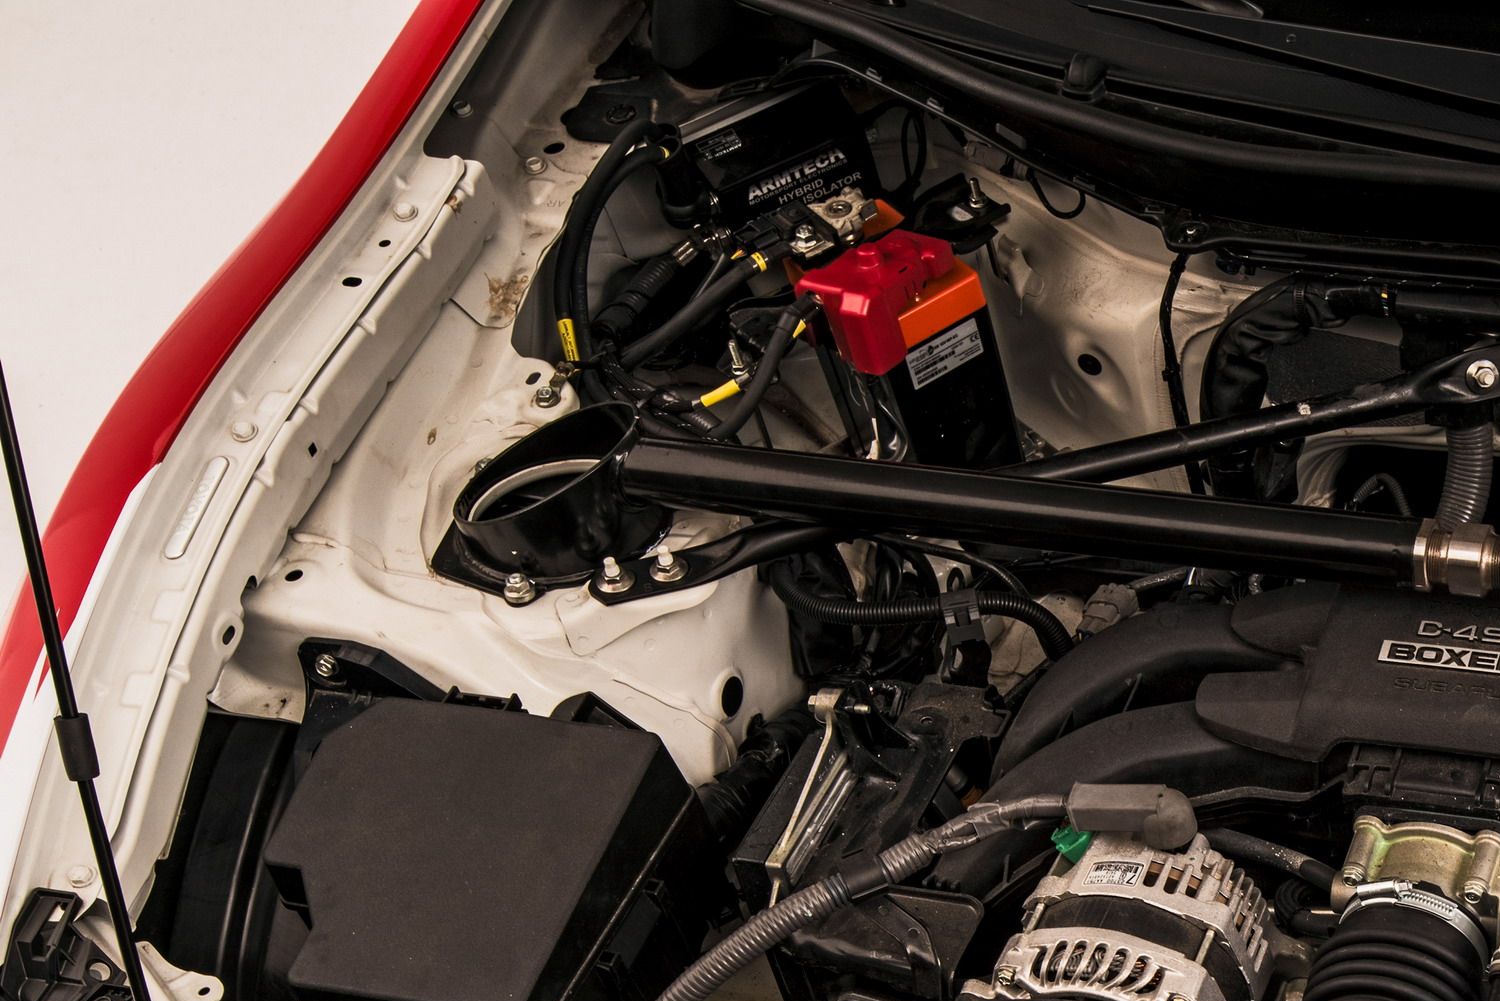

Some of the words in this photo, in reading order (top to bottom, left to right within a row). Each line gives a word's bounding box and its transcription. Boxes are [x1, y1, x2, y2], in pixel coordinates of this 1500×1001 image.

[748, 147, 847, 202] ARMTECH
[802, 171, 863, 205] ISOLATOR
[778, 178, 825, 206] HYBRID
